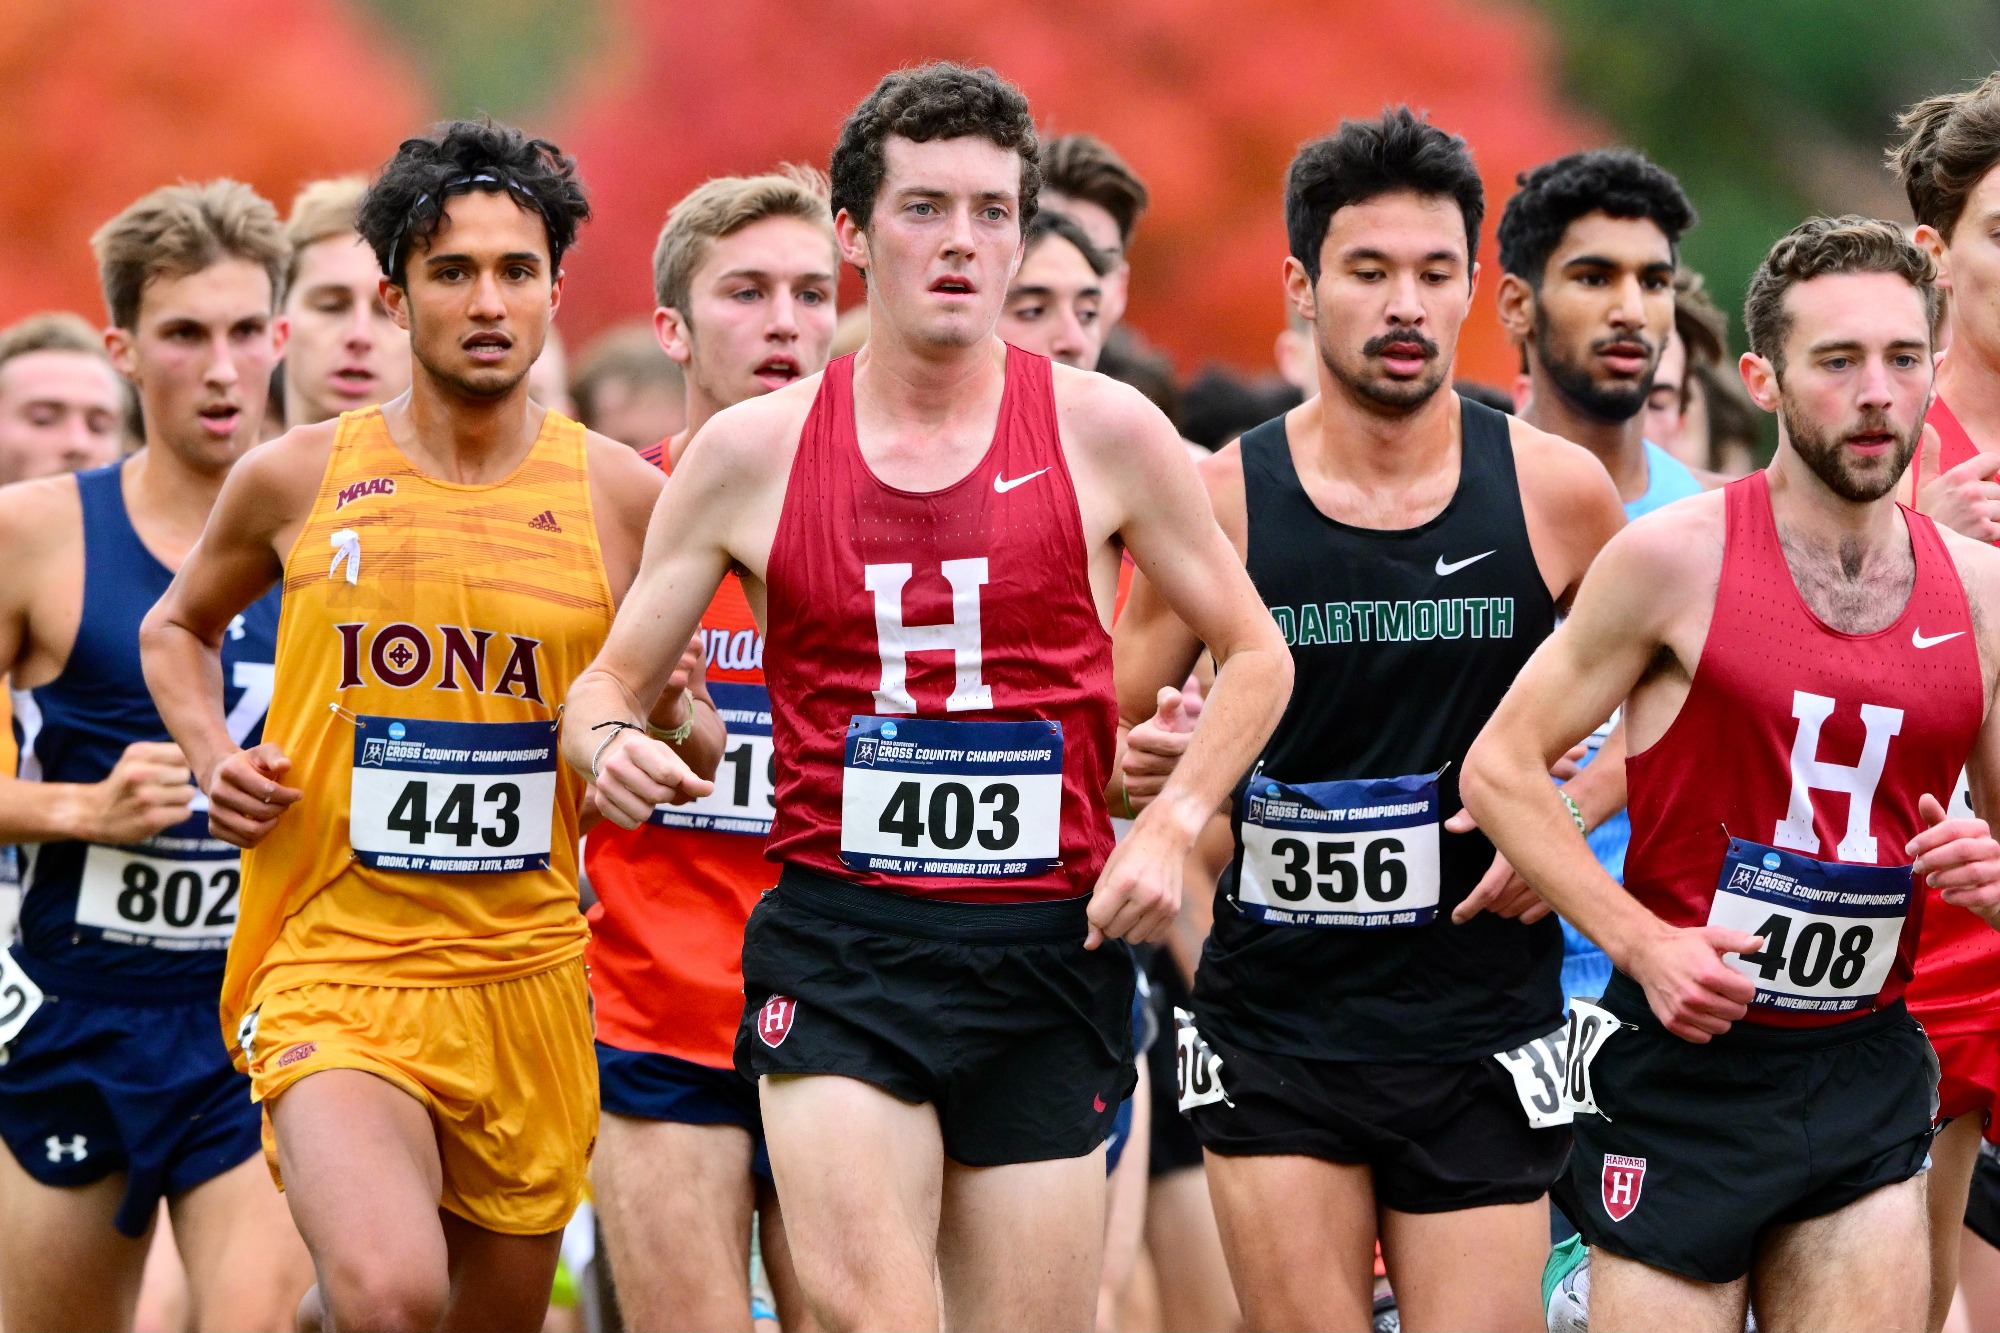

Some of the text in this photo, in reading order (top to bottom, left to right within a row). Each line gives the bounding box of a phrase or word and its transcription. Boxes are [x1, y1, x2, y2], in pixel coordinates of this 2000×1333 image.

[335, 478, 395, 512] MAAC
[528, 521, 562, 533] adidas
[864, 556, 994, 714] H
[1270, 597, 1514, 647] DARTMOUTH
[333, 621, 549, 708] IONA
[716, 709, 755, 723] OUNTRY
[386, 746, 420, 759] CROSS
[422, 748, 469, 762] COUNTRY
[472, 748, 549, 763] CHAMPIONSHIPS
[878, 745, 914, 760] CROSS
[915, 748, 965, 762] COUNTRY
[966, 749, 1051, 763] CHAMPIONSHIPS
[1773, 689, 1904, 863] H
[387, 780, 521, 848] 443
[879, 781, 1020, 851] 403
[1265, 804, 1299, 819] CROSS
[1300, 807, 1347, 821] COUNTRY
[1347, 800, 1430, 821] CHAMPIONSHIPS
[376, 855, 411, 870] BRONX,
[411, 857, 425, 869] NY
[430, 859, 479, 871] NOVEMBER
[479, 859, 503, 872] 10TH,
[503, 858, 525, 871] 2023
[869, 857, 901, 872] BRONX,
[904, 861, 918, 871] NY
[924, 862, 975, 874] NOVEMBER
[976, 862, 1002, 875] 10TH,
[1003, 862, 1028, 873] 2023
[1271, 837, 1408, 903] 356
[117, 861, 241, 928] 802
[1754, 874, 1793, 893] CROSS
[1793, 885, 1839, 903] COUNTRY
[1839, 892, 1906, 906] CHAMPIONSHIPS
[1264, 909, 1296, 925] BRONX,
[1296, 913, 1310, 924] NY
[1316, 913, 1365, 926] NOVEMBER
[1365, 914, 1391, 927] 10TH,
[1392, 912, 1417, 924] 2023
[1739, 913, 1874, 989] 408
[764, 1001, 788, 1033] H
[1756, 993, 1772, 1004] NY
[1775, 996, 1819, 1010] NOVEMBER
[1606, 1155, 1645, 1168] HARVARD
[1609, 1171, 1635, 1206] H
